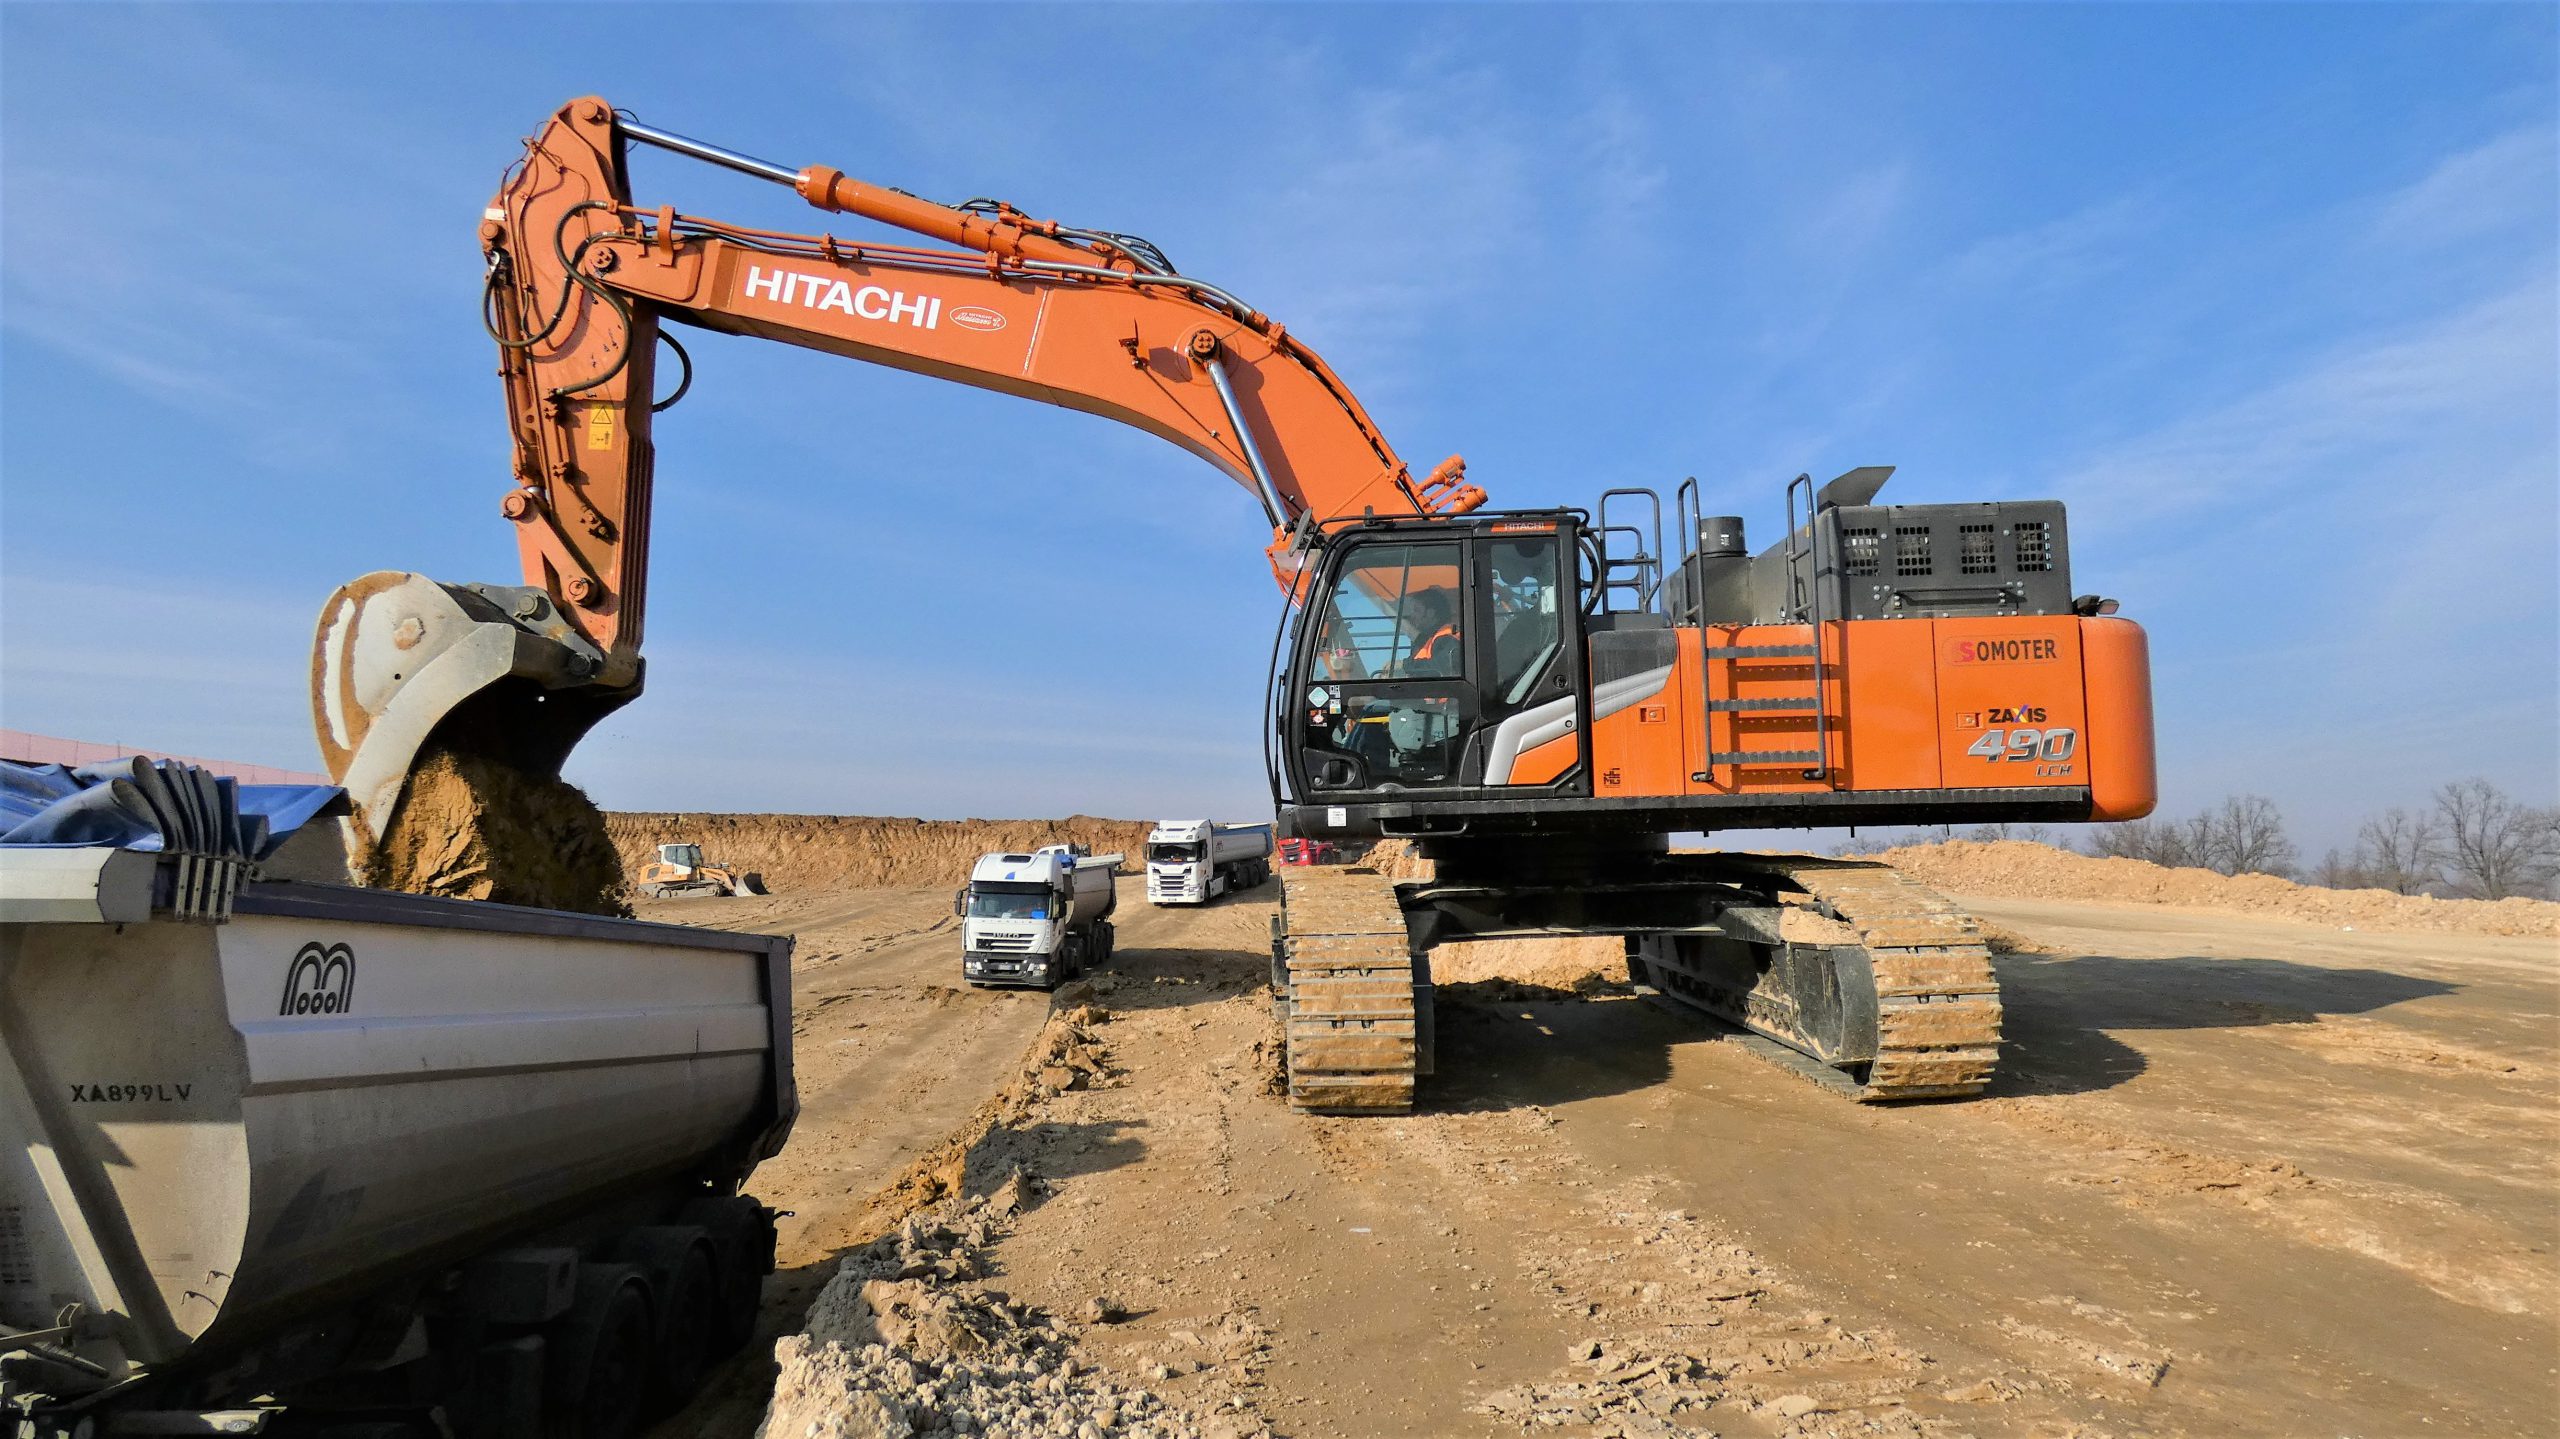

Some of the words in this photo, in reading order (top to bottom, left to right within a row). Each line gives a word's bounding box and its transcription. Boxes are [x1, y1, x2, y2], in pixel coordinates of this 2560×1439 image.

[745, 266, 941, 329] HITACHI
[1504, 522, 1545, 531] HITACHI
[1957, 639, 2056, 662] SOMOTER
[1988, 704, 2047, 724] ZAXIS
[1967, 728, 2077, 763] 490
[2035, 764, 2072, 777] LCH
[71, 1083, 192, 1102] XA899LV
